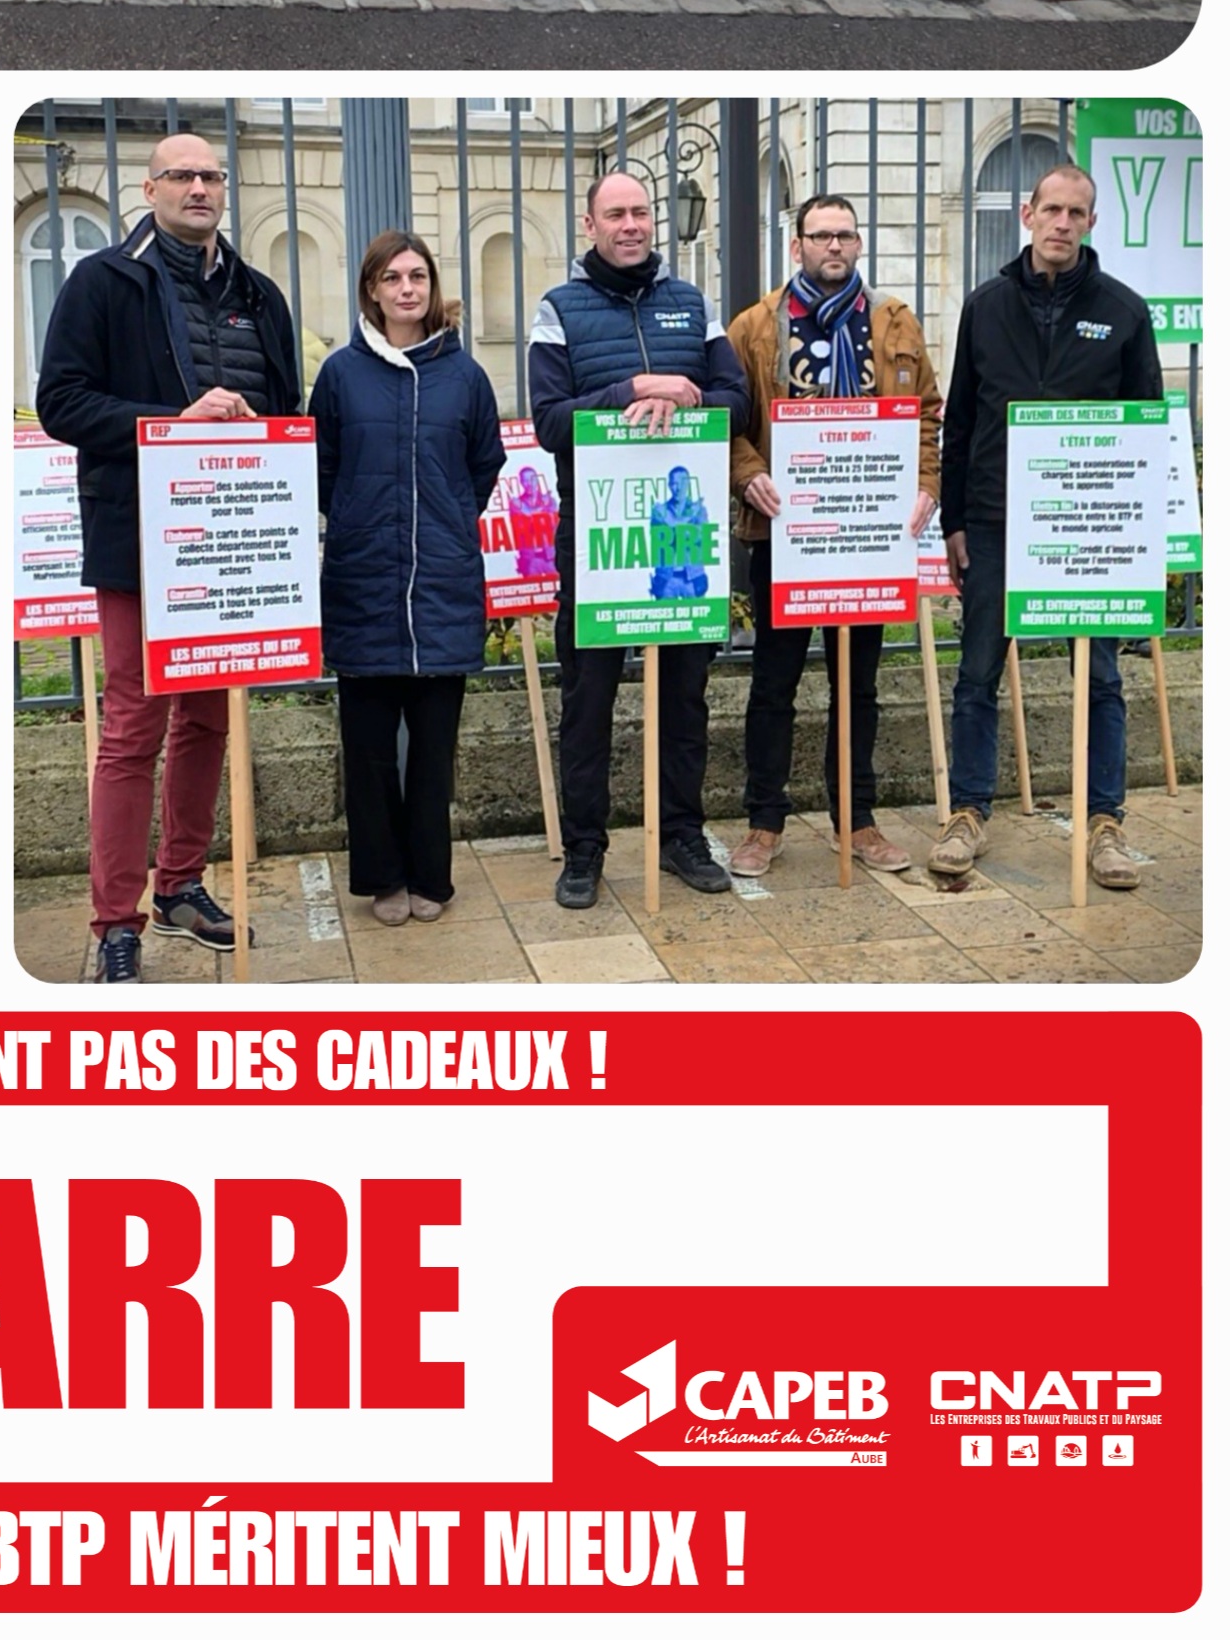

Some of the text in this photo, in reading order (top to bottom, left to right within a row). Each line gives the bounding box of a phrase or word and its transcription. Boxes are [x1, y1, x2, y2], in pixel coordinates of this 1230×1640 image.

[1134, 108, 1178, 137] VOS
[1111, 155, 1166, 248] Y
[780, 404, 873, 417] MICRO-ENTREPRISES
[1019, 410, 1054, 421] AVENIR
[1056, 410, 1075, 420] DES
[595, 413, 617, 427] VOS
[683, 411, 710, 425] SONT
[150, 424, 171, 438] REP
[607, 426, 628, 440] PAS
[819, 430, 873, 443] L'ÉTAT DOIT
[1060, 435, 1118, 448] L'ÉTAT DOIT
[199, 455, 262, 471] L'ÉTAT DOIT
[235, 480, 275, 492] solutions
[277, 480, 288, 491] de
[205, 495, 222, 505] des
[261, 491, 293, 504] partout
[588, 477, 668, 521] Y EN
[588, 523, 721, 572] MARRE
[1027, 598, 1147, 612] LES ENTREPRISES DU BTP
[596, 605, 711, 623] LES ENTREPRISES DU BTP
[171, 637, 302, 663] LES ENTREPRISES DU BTP
